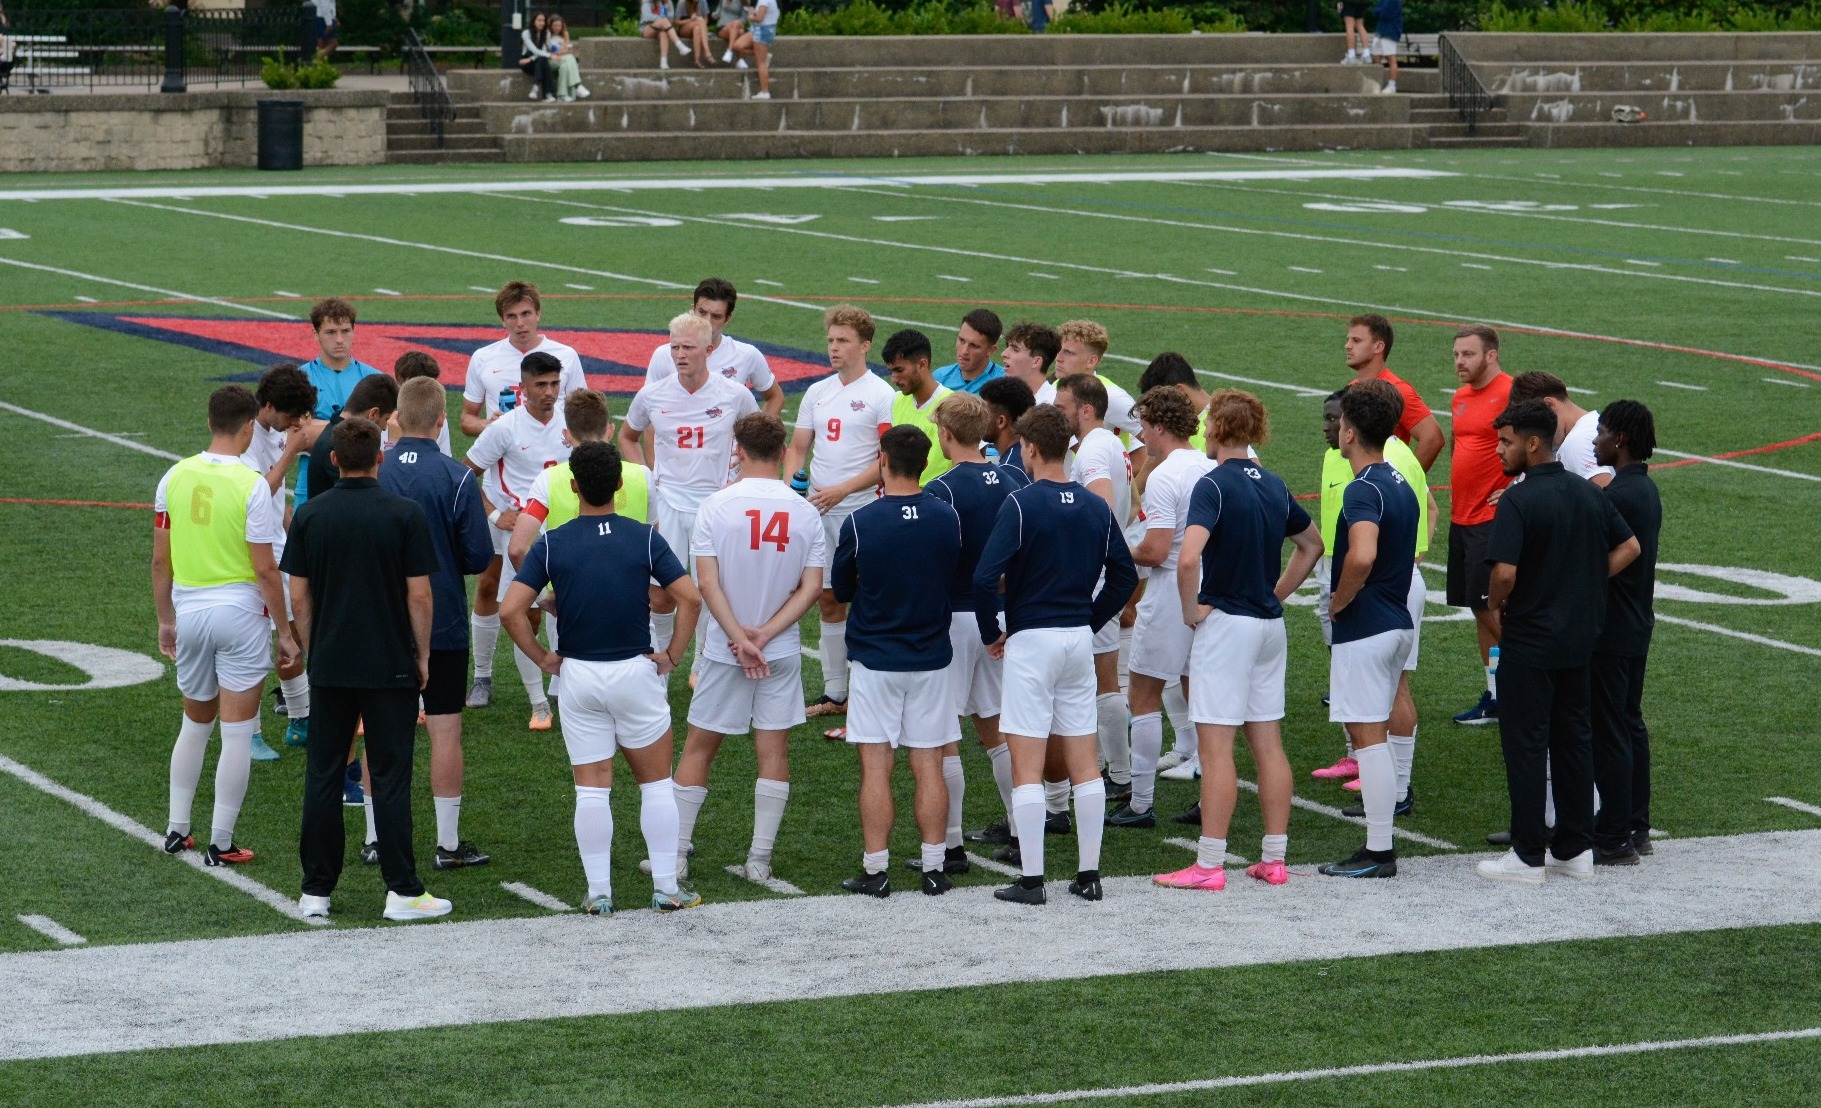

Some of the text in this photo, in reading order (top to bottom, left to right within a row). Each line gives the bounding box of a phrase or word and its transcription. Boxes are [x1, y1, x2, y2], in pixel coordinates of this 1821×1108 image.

[827, 418, 841, 441] 9
[677, 426, 704, 448] 21
[399, 452, 418, 463] 40
[983, 471, 999, 484] 32
[1243, 467, 1262, 479] 23
[191, 485, 213, 526] 6
[902, 506, 918, 519] 31
[598, 522, 611, 535] 11
[745, 509, 790, 552] 14
